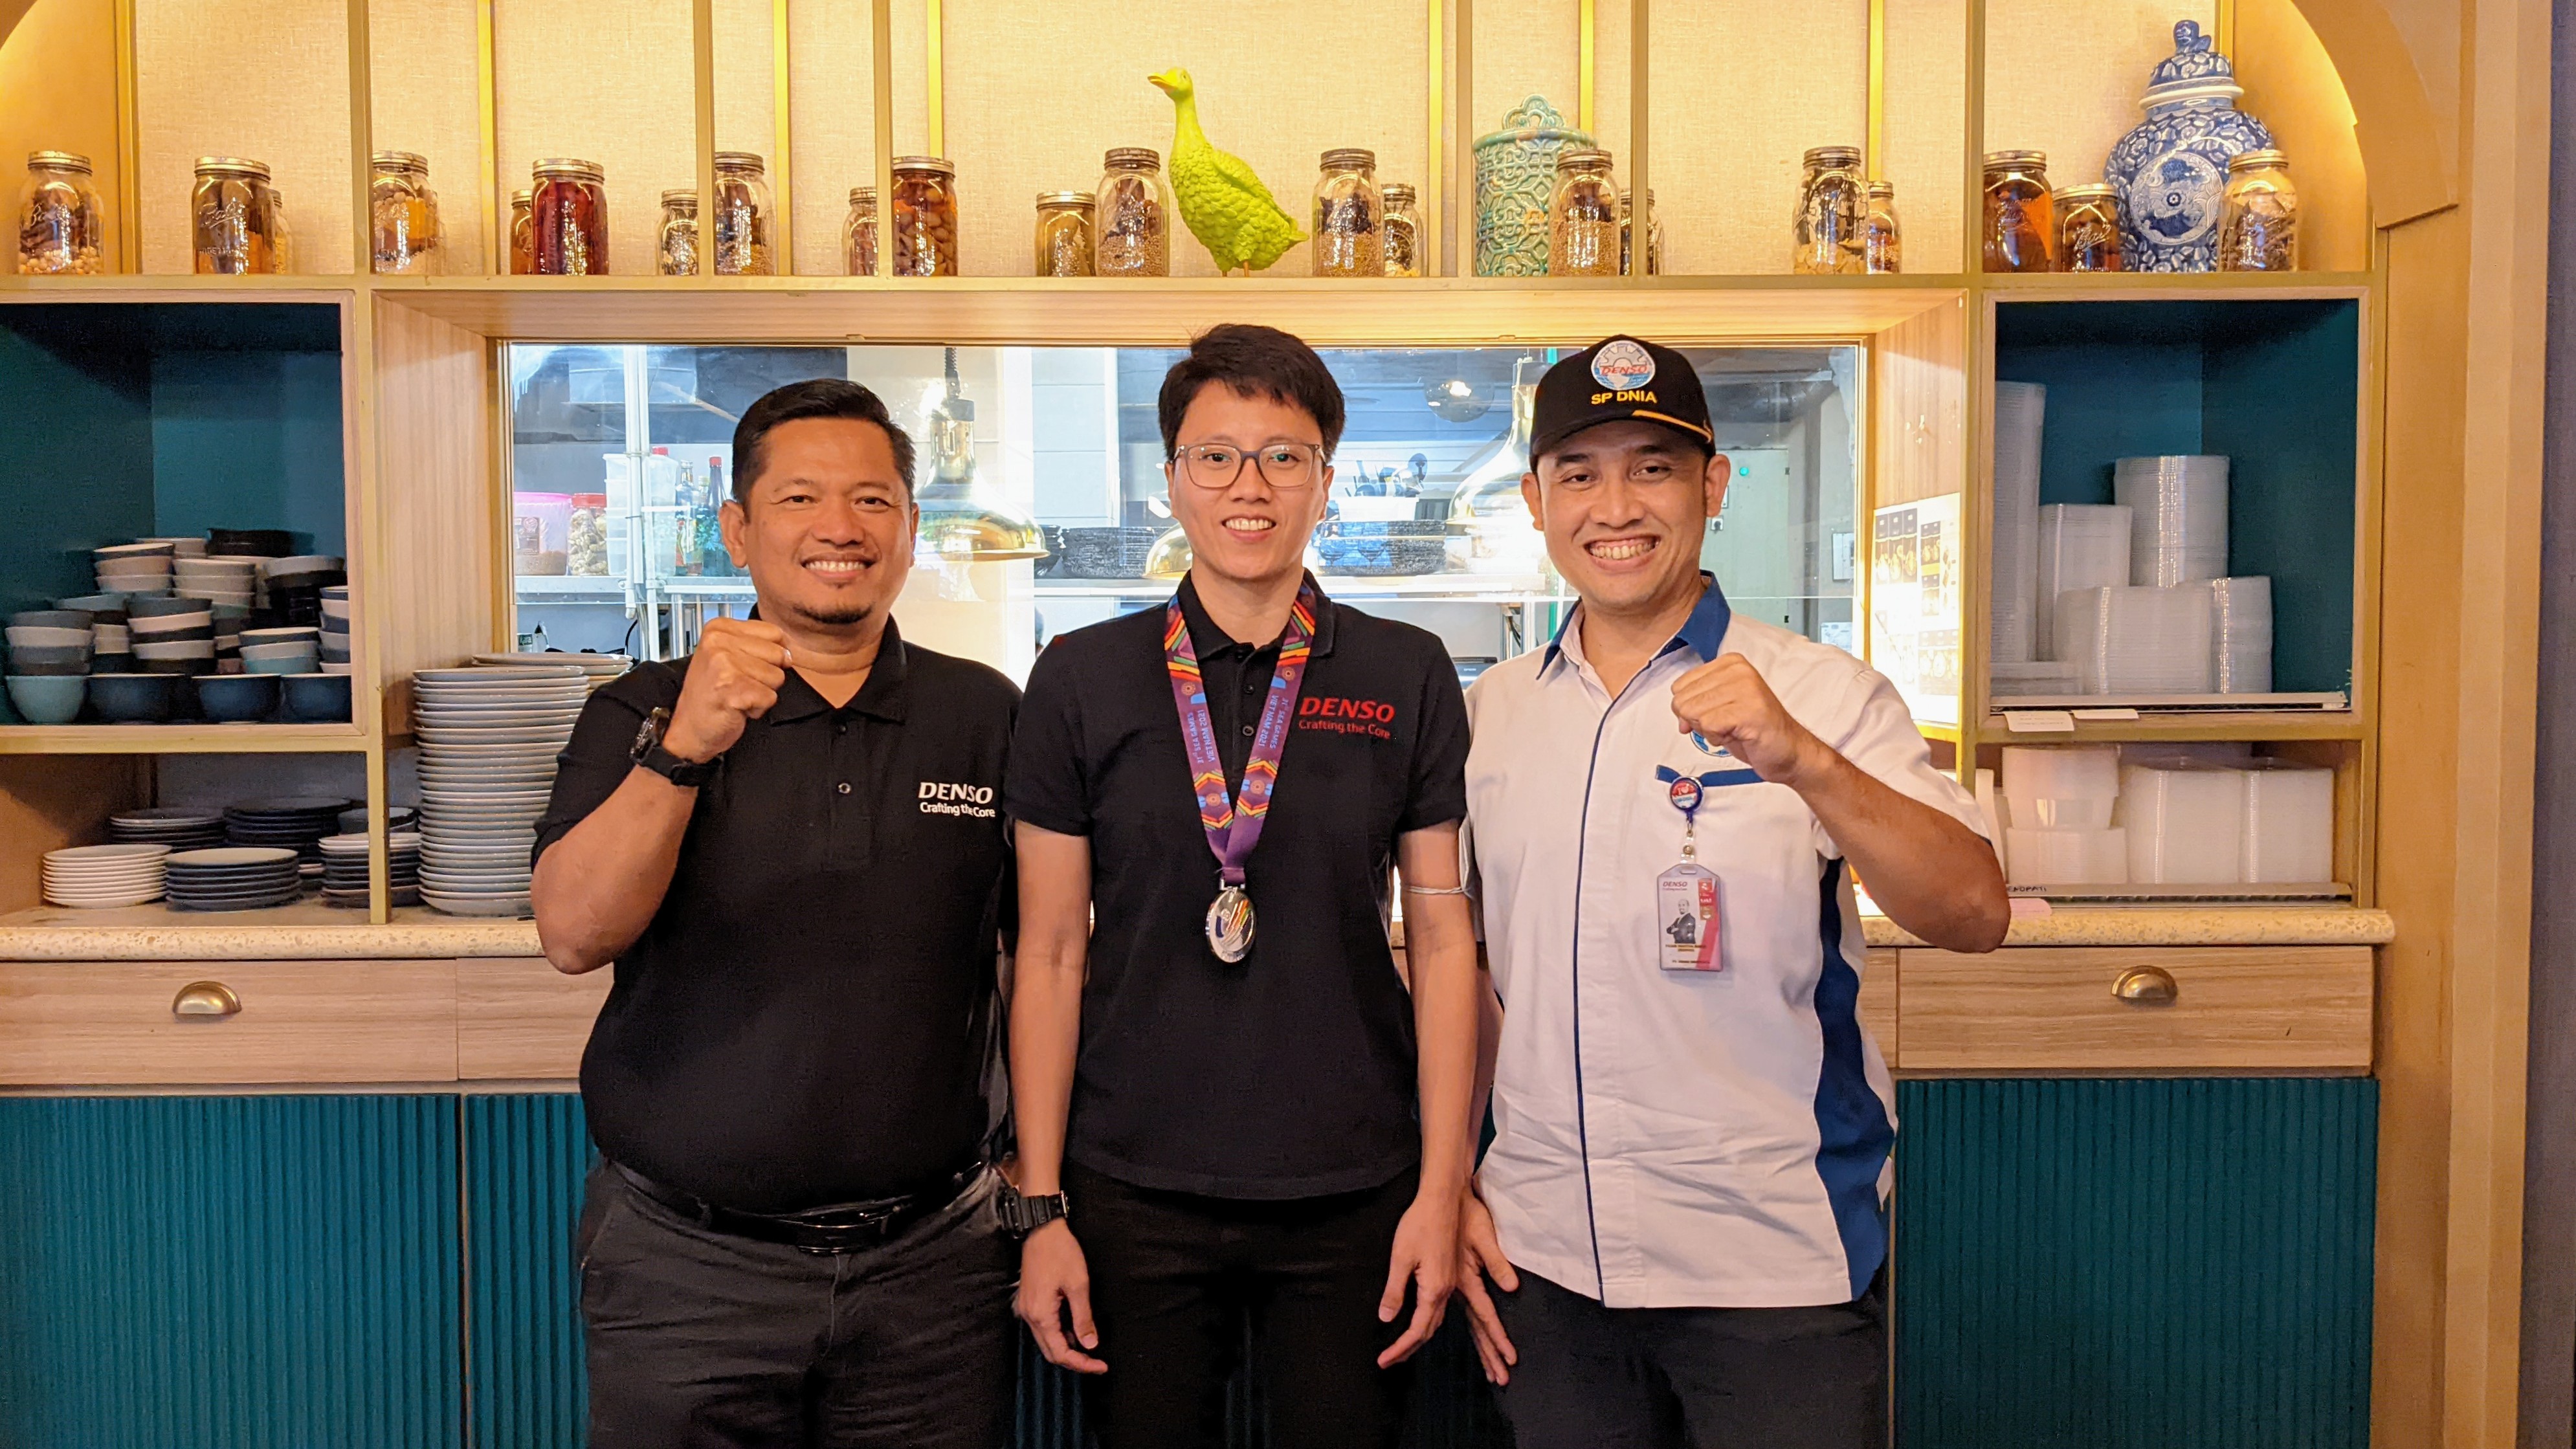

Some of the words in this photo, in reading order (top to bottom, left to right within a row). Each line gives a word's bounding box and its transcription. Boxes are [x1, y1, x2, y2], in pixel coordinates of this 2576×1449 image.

[1601, 365, 1647, 376] DENSO
[1591, 392, 1613, 404] SP
[1617, 390, 1658, 404] DNIA
[1197, 709, 1207, 727] 2021
[1298, 697, 1395, 723] DENSO
[1258, 729, 1269, 746] 2021
[1298, 719, 1346, 735] Crafting
[1347, 722, 1366, 734] the
[1368, 723, 1391, 740] Core
[918, 782, 994, 804] DENSO
[920, 802, 960, 817] Crafting
[960, 804, 973, 815] the
[973, 806, 996, 818] Core
